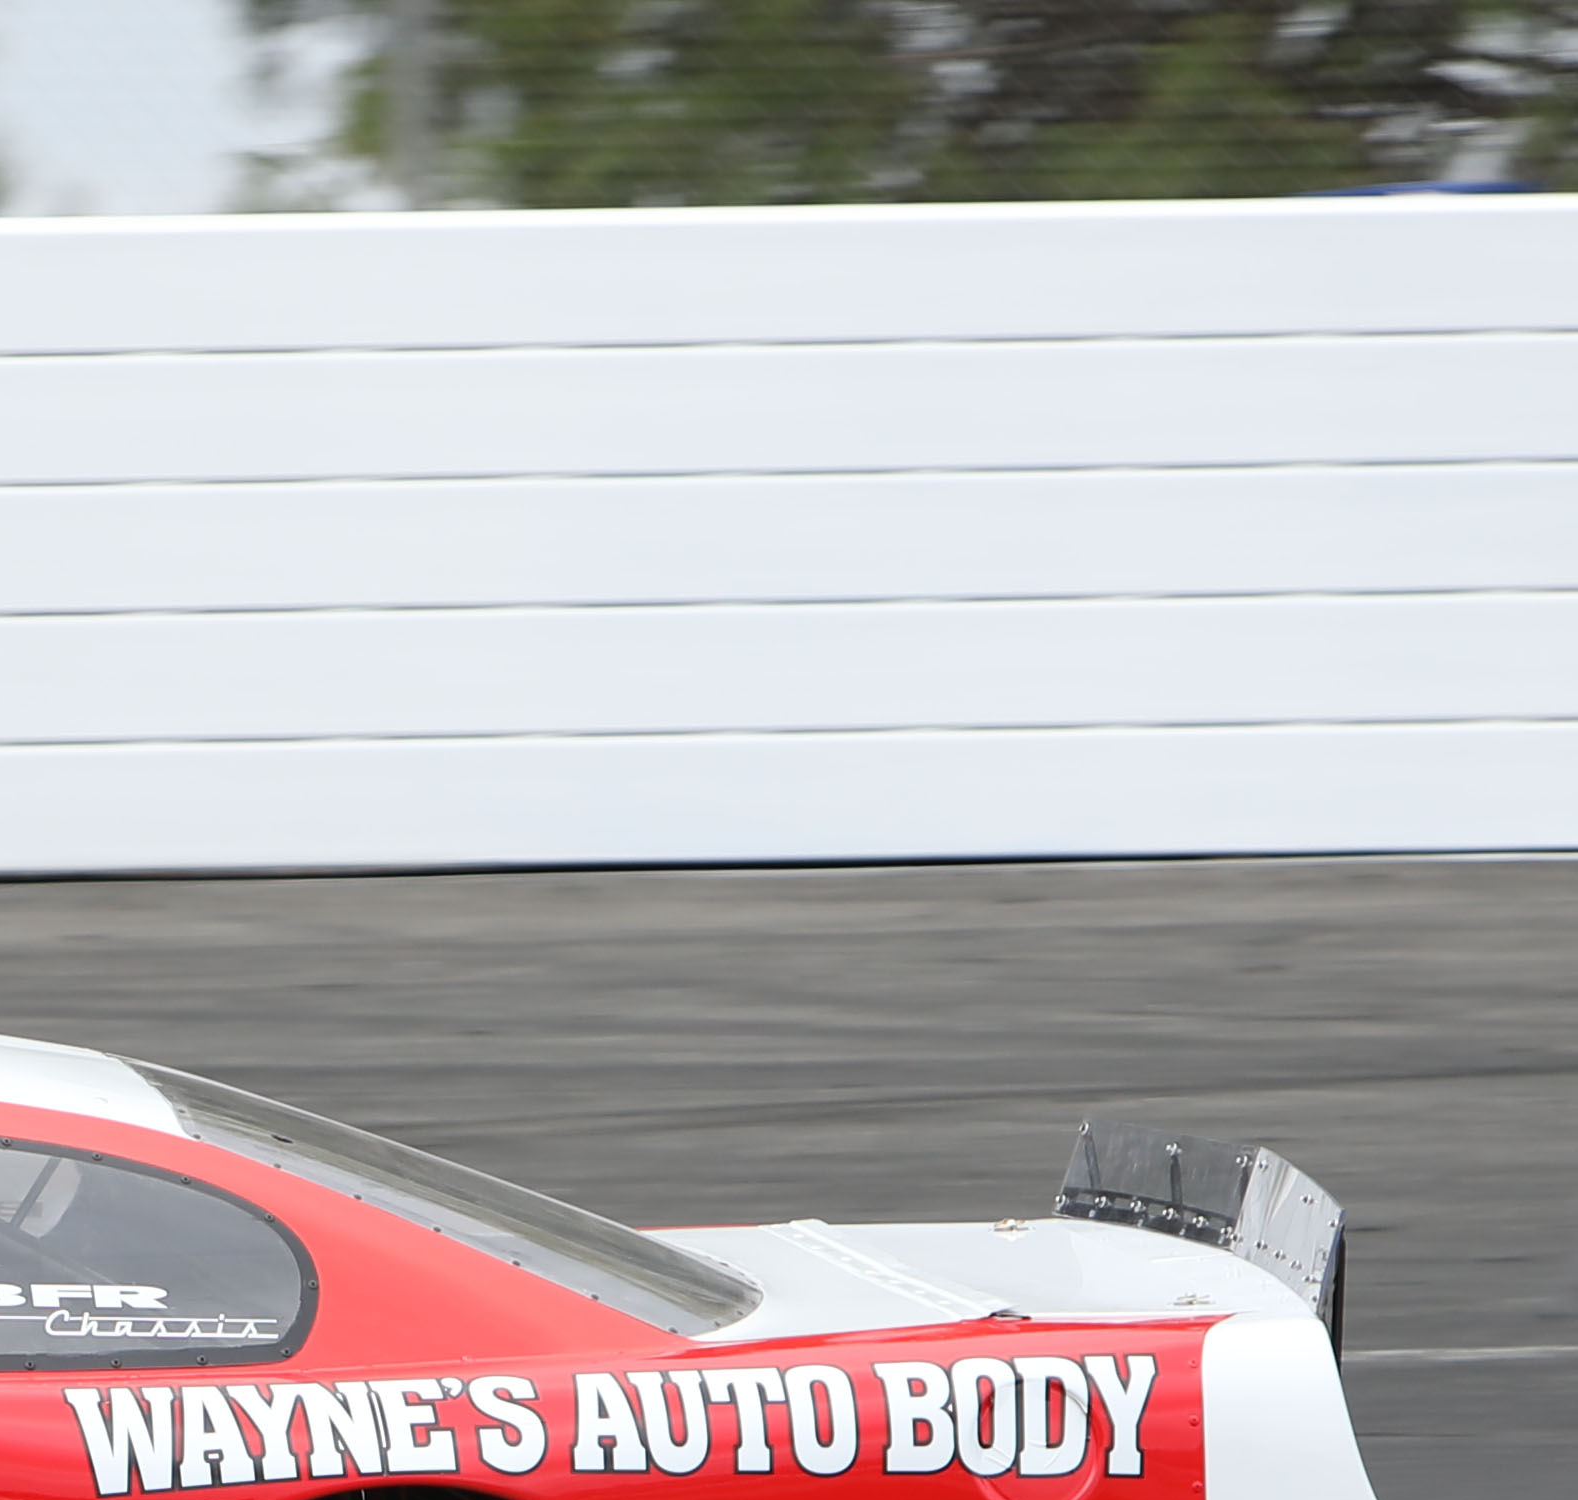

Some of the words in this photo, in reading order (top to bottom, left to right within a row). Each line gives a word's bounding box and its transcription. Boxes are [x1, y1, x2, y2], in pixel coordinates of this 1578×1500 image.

[45, 1309, 279, 1338] Chassis
[63, 1374, 547, 1498] WAYNE'S
[571, 1364, 859, 1476] AUTO
[872, 1353, 1157, 1478] BODY
